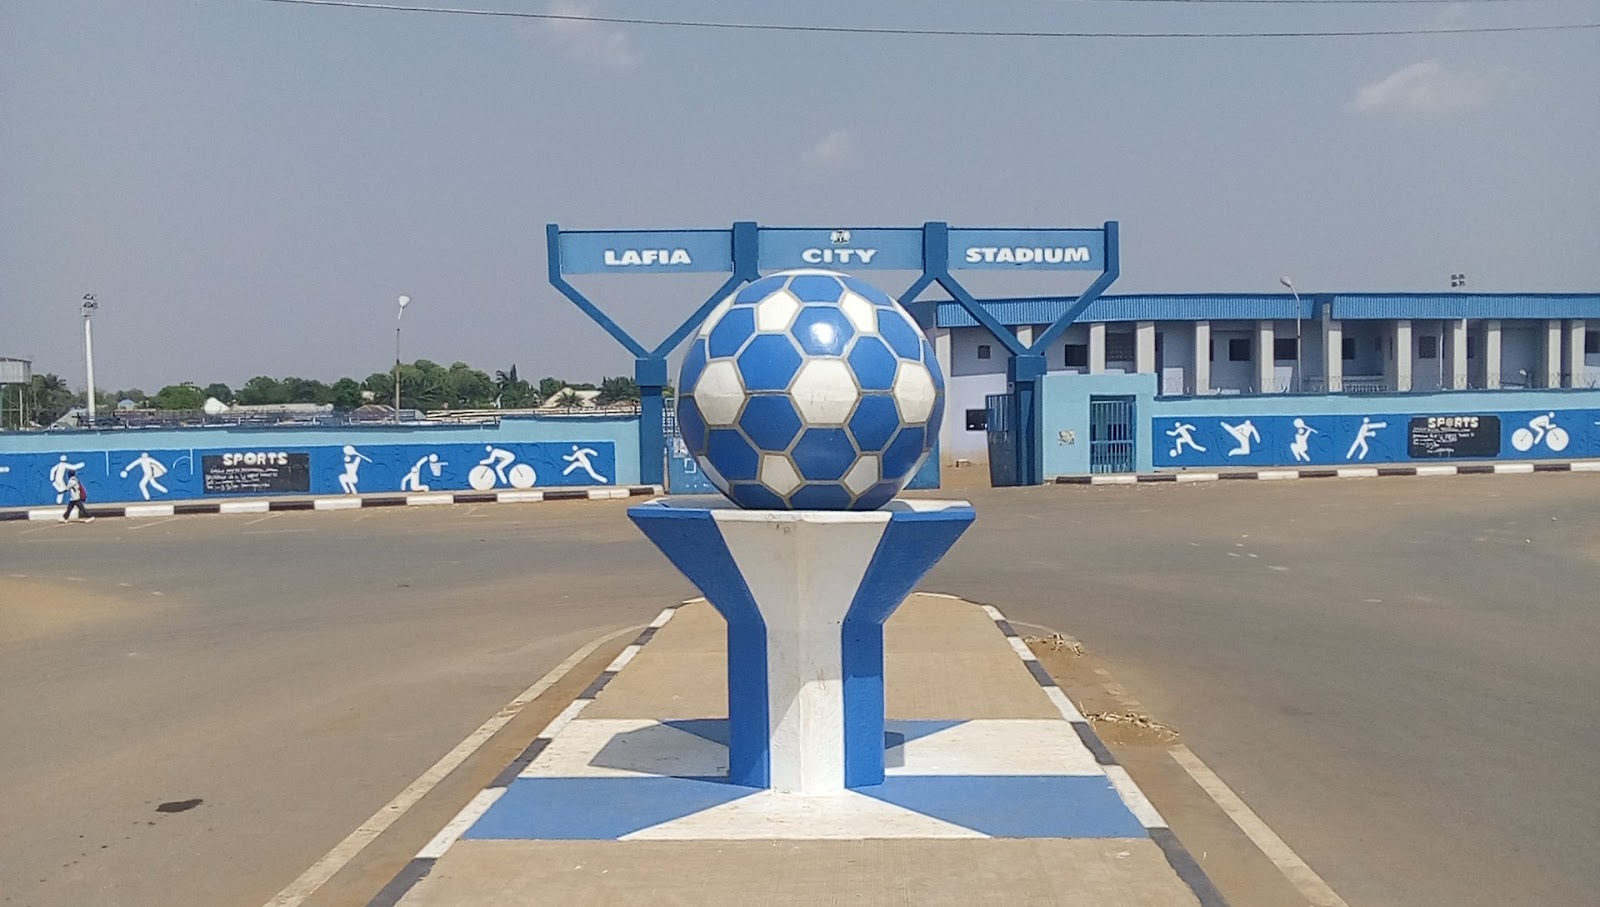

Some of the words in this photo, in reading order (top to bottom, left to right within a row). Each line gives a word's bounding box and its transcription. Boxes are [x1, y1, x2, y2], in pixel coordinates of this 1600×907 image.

[603, 248, 692, 266] LAFIA
[801, 248, 878, 264] CITY
[965, 246, 1090, 263] STADIUM
[1427, 416, 1479, 429] SPORTS
[222, 451, 288, 466] SPORTS
